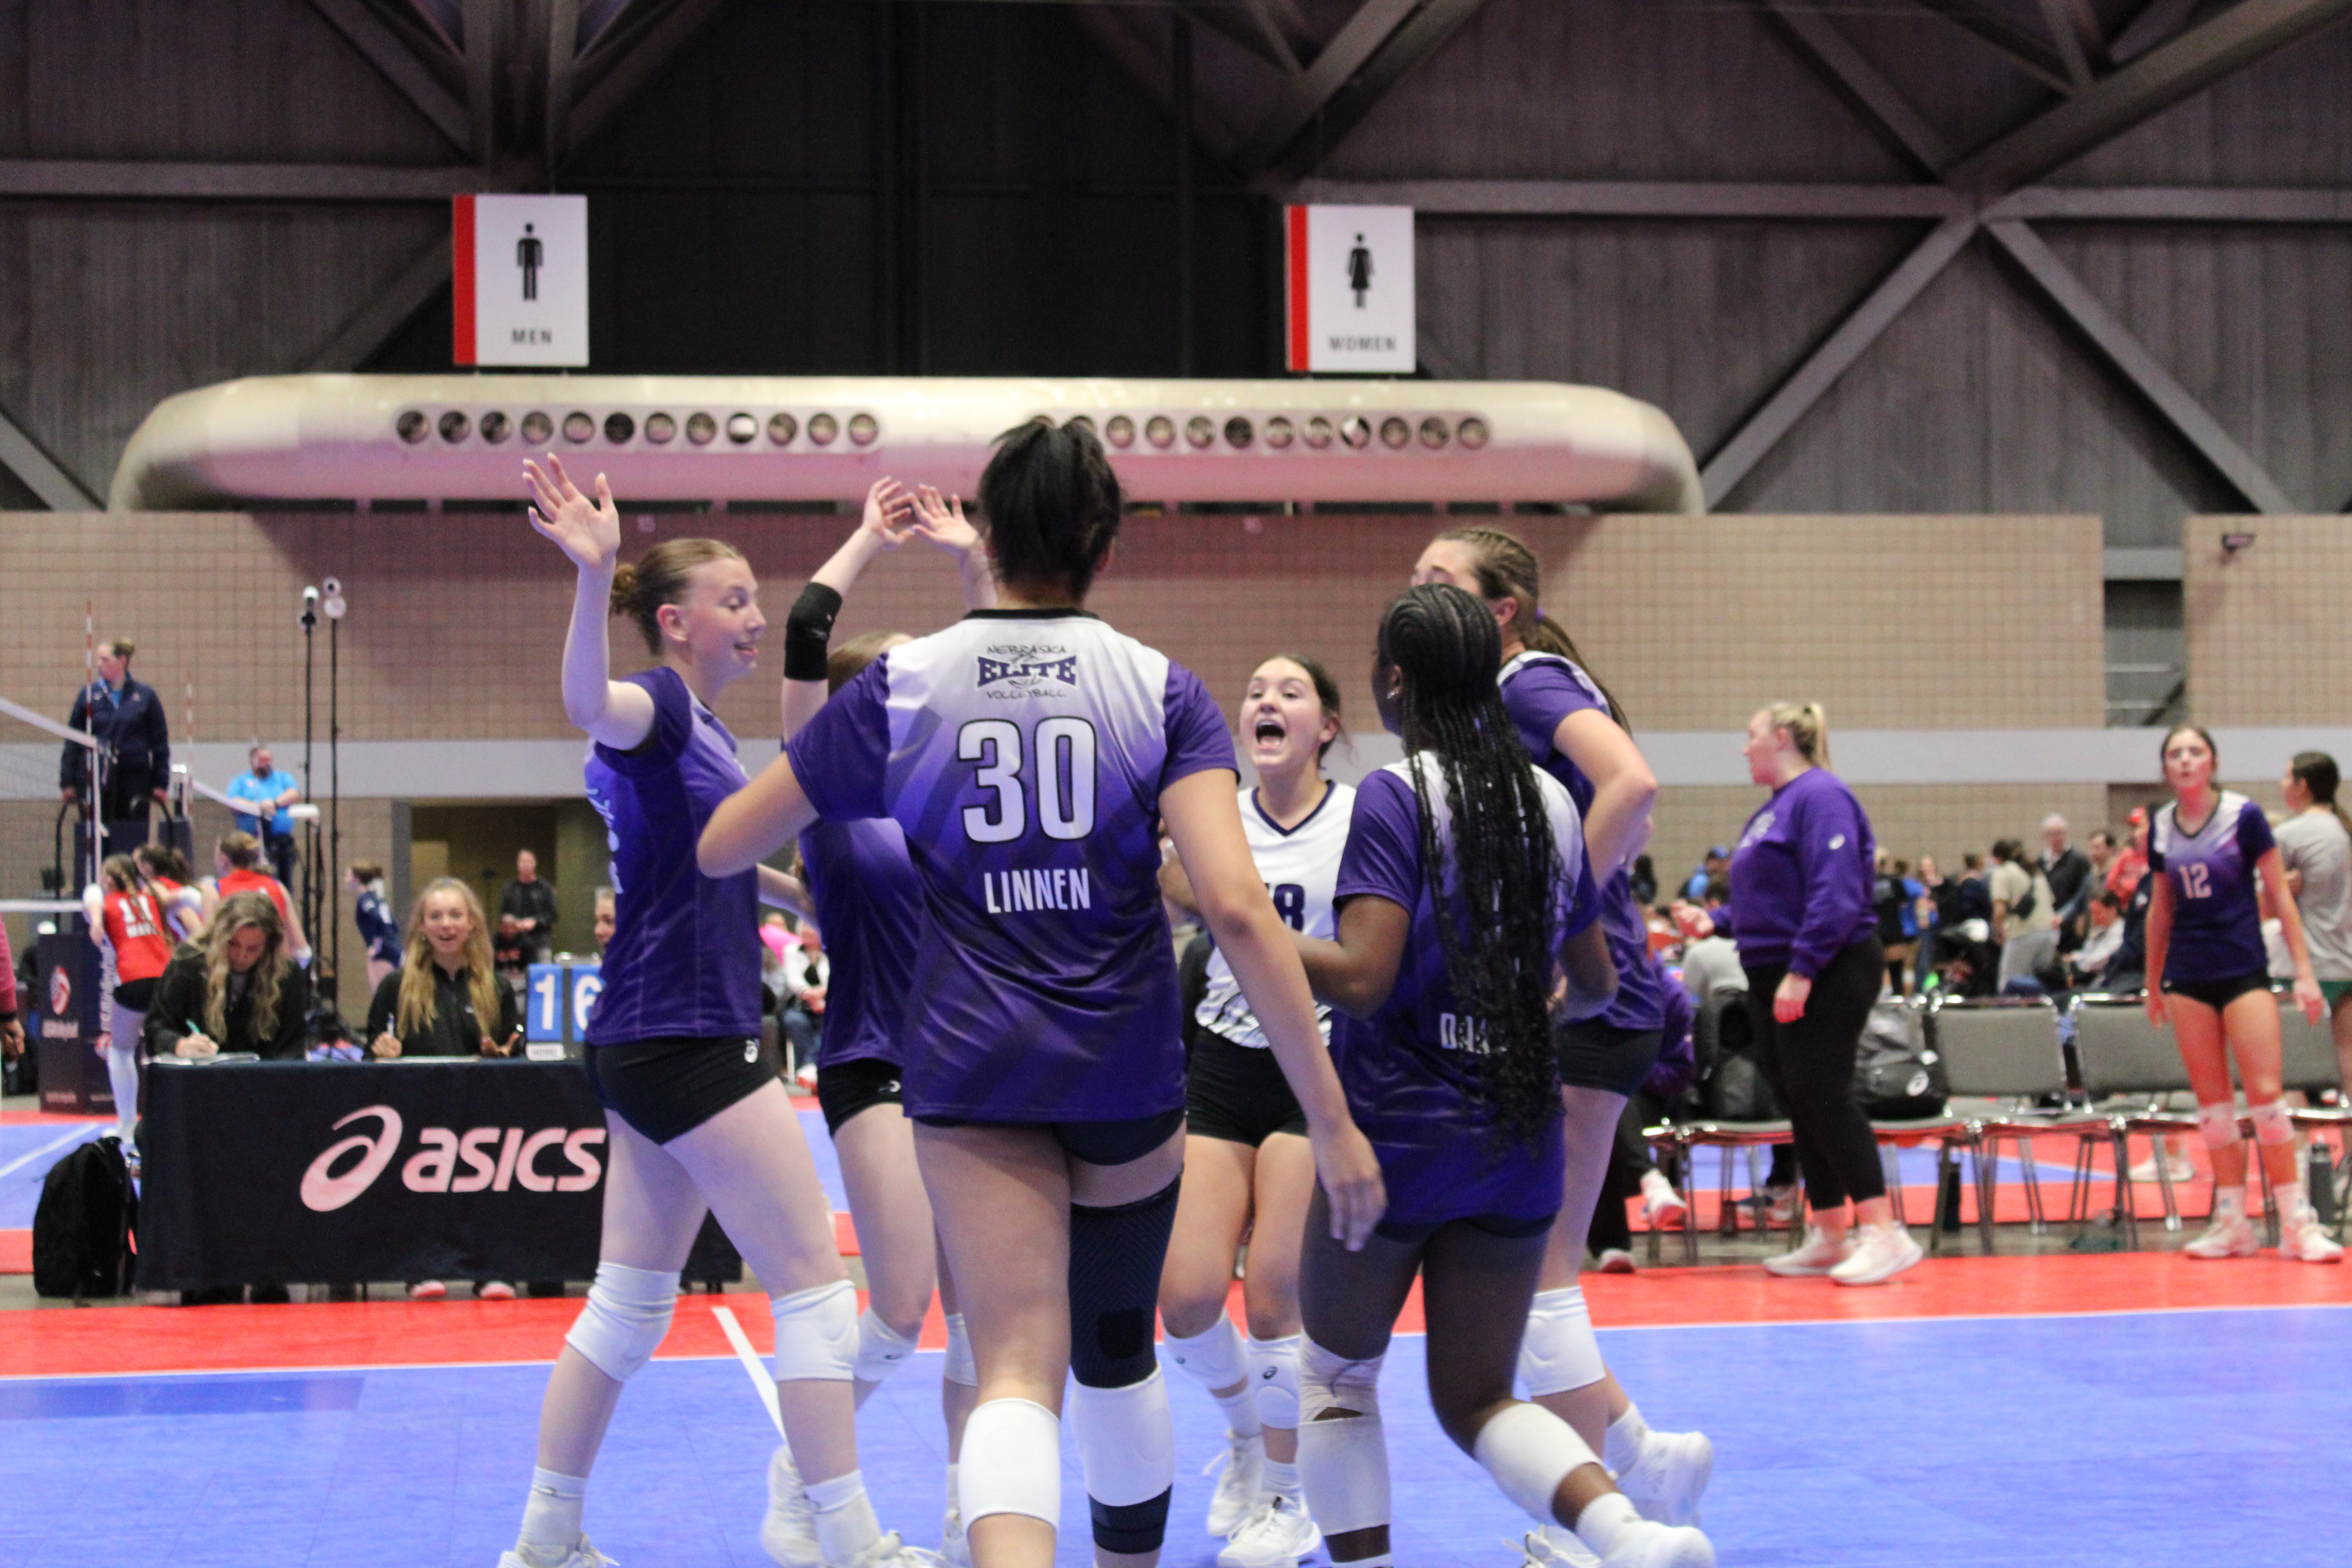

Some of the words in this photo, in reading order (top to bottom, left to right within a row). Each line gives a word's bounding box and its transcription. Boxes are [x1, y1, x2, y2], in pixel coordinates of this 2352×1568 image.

[512, 329, 552, 344] MEN
[1329, 336, 1396, 351] WOMEN
[987, 644, 1066, 655] NEBRASKA
[978, 655, 1076, 688] ELITE
[986, 688, 1066, 699] VOLLEYBALL
[957, 716, 1097, 843] 30
[984, 867, 1091, 914] LINNEN
[2178, 863, 2212, 899] 12
[1265, 883, 1305, 932] 8
[401, 1127, 607, 1192] asics
